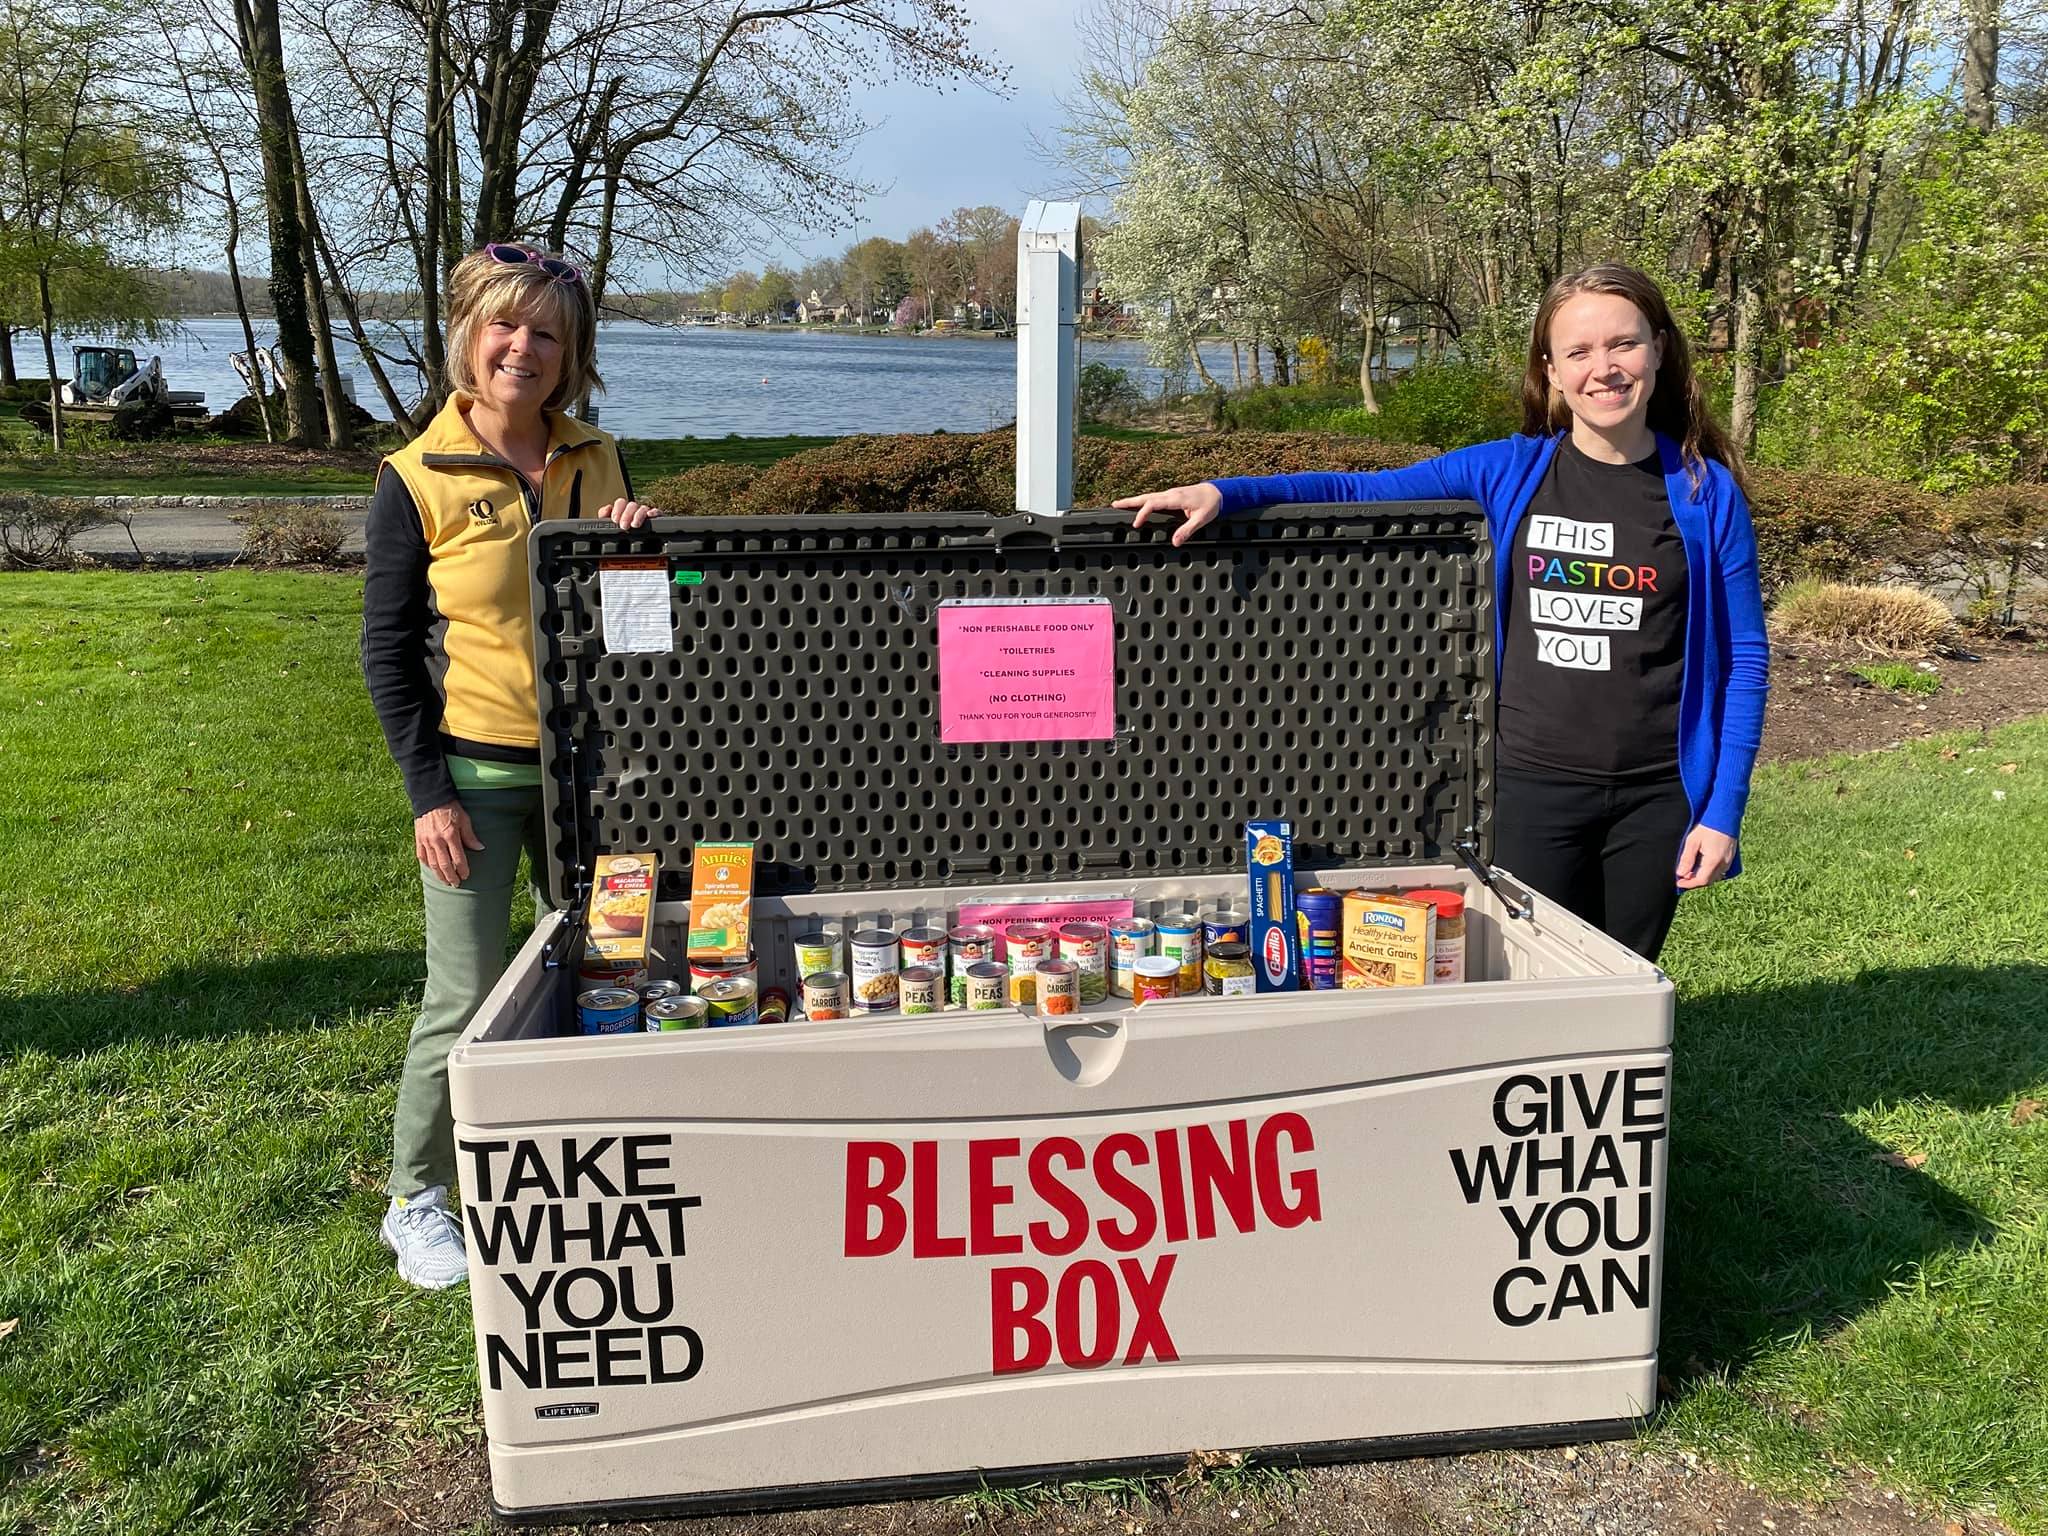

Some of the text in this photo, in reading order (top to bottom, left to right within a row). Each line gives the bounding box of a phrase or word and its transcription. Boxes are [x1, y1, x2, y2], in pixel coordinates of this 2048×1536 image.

[1537, 520, 1607, 551] THIS
[1528, 554, 1659, 592] PASTOR
[1537, 593, 1635, 625] LOVES
[985, 624, 1041, 632] PERISHABLE
[1044, 624, 1068, 632] FOOD
[1071, 623, 1094, 631] ONLY
[1537, 635, 1603, 665] YOU
[1032, 669, 1075, 677] SUPPLIES
[989, 694, 1066, 704] (NO CLOTHING)
[959, 713, 984, 721] THANK
[1004, 712, 1019, 720] FOR
[701, 852, 748, 868] Annie's
[1255, 877, 1264, 917] SPAGHETTI
[1090, 915, 1114, 923] ONLY
[1349, 941, 1384, 956] Ancient
[1387, 947, 1418, 960] Grains
[1353, 926, 1384, 941] Healthy
[1384, 931, 1417, 944] Harvest
[1267, 931, 1281, 973] Barilla
[812, 997, 841, 1008] CARROTS
[905, 991, 934, 1003] PEAS
[975, 987, 1003, 1000] PEAS
[600, 1015, 636, 1033] PROGRESSO
[1492, 1066, 1666, 1137] GIVE
[459, 1134, 676, 1202] TAKE
[1448, 1127, 1667, 1204] WHAT
[844, 1112, 1322, 1259] BLESSING
[466, 1196, 702, 1266] WHAT
[1498, 1192, 1652, 1261] YOU
[499, 1263, 675, 1330] YOU
[1493, 1254, 1650, 1327] CAN
[991, 1254, 1181, 1377] BOX
[486, 1325, 704, 1391] NEED
[544, 1406, 591, 1416] LIFETIME
